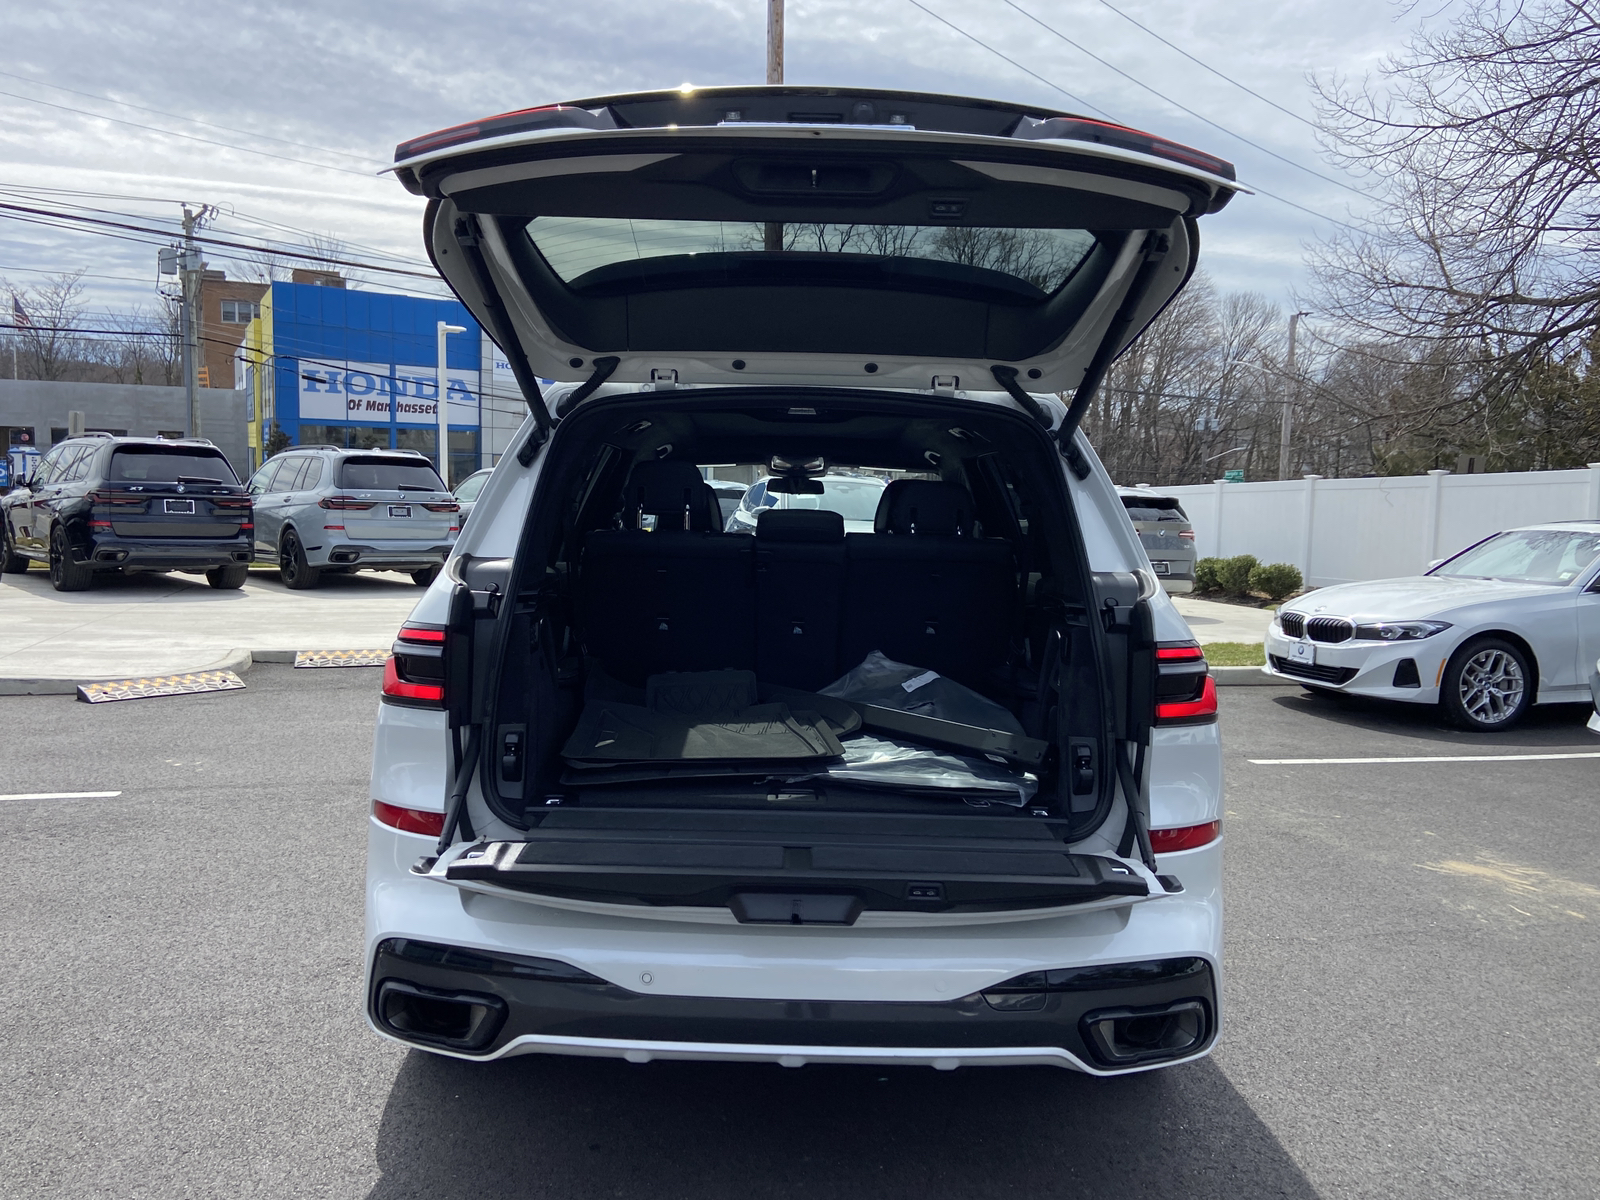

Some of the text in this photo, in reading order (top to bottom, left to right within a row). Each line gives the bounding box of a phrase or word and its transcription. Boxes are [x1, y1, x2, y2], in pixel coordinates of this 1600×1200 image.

[302, 369, 476, 401] HONDA
[348, 399, 437, 414] Of Manhasset
